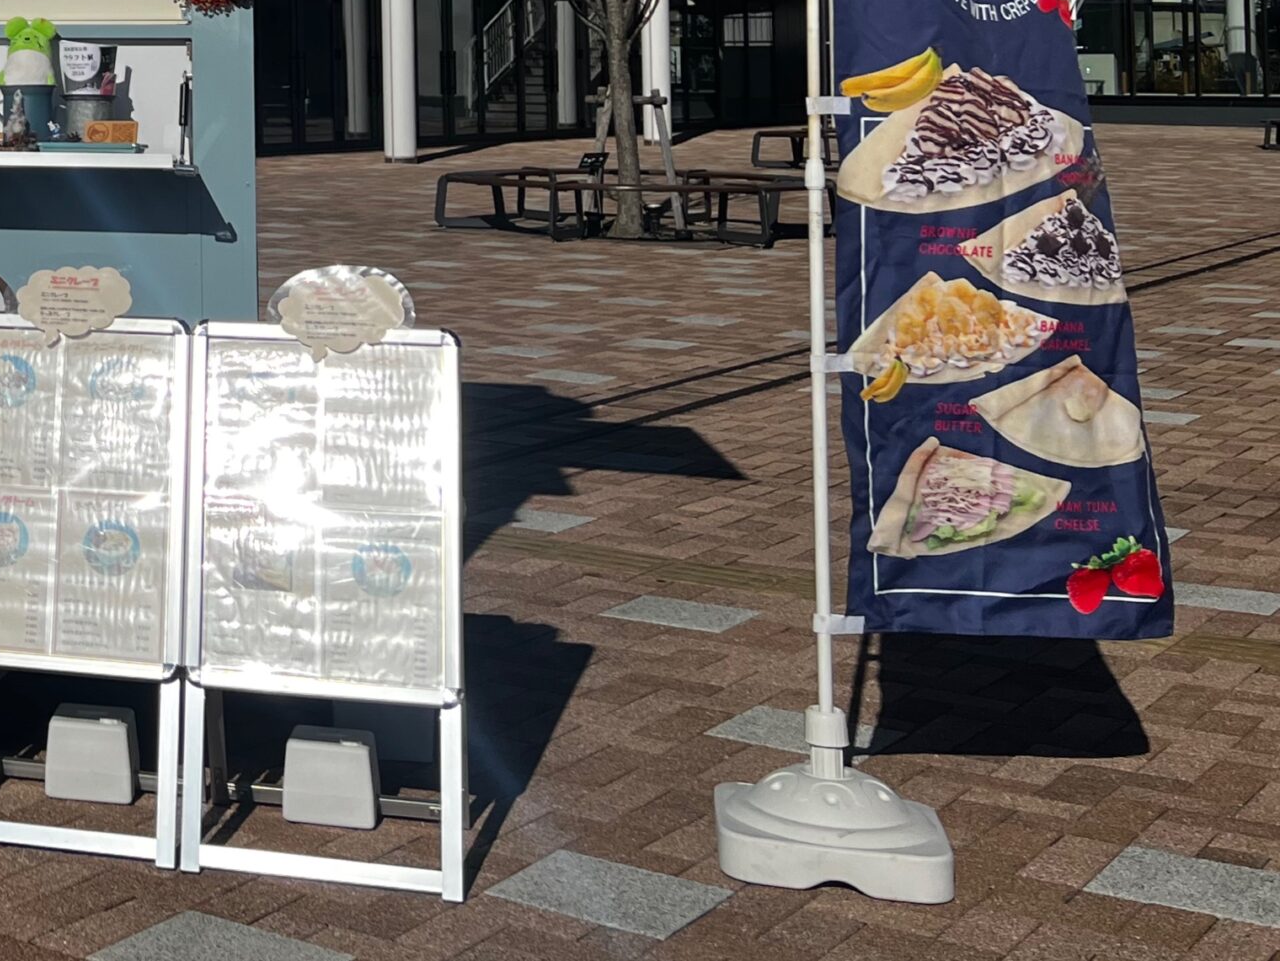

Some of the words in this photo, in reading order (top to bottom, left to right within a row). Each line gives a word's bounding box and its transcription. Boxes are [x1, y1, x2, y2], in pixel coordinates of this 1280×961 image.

[919, 224, 978, 240] BROWNIE
[918, 243, 994, 259] CHOCOLATE
[1039, 319, 1085, 334] BANANA
[1039, 339, 1092, 352] CARAMEL
[936, 402, 978, 416] SUGAR
[933, 420, 983, 434] BUTTER
[1086, 500, 1118, 513] TUNA
[1054, 518, 1101, 531] CHEESE
